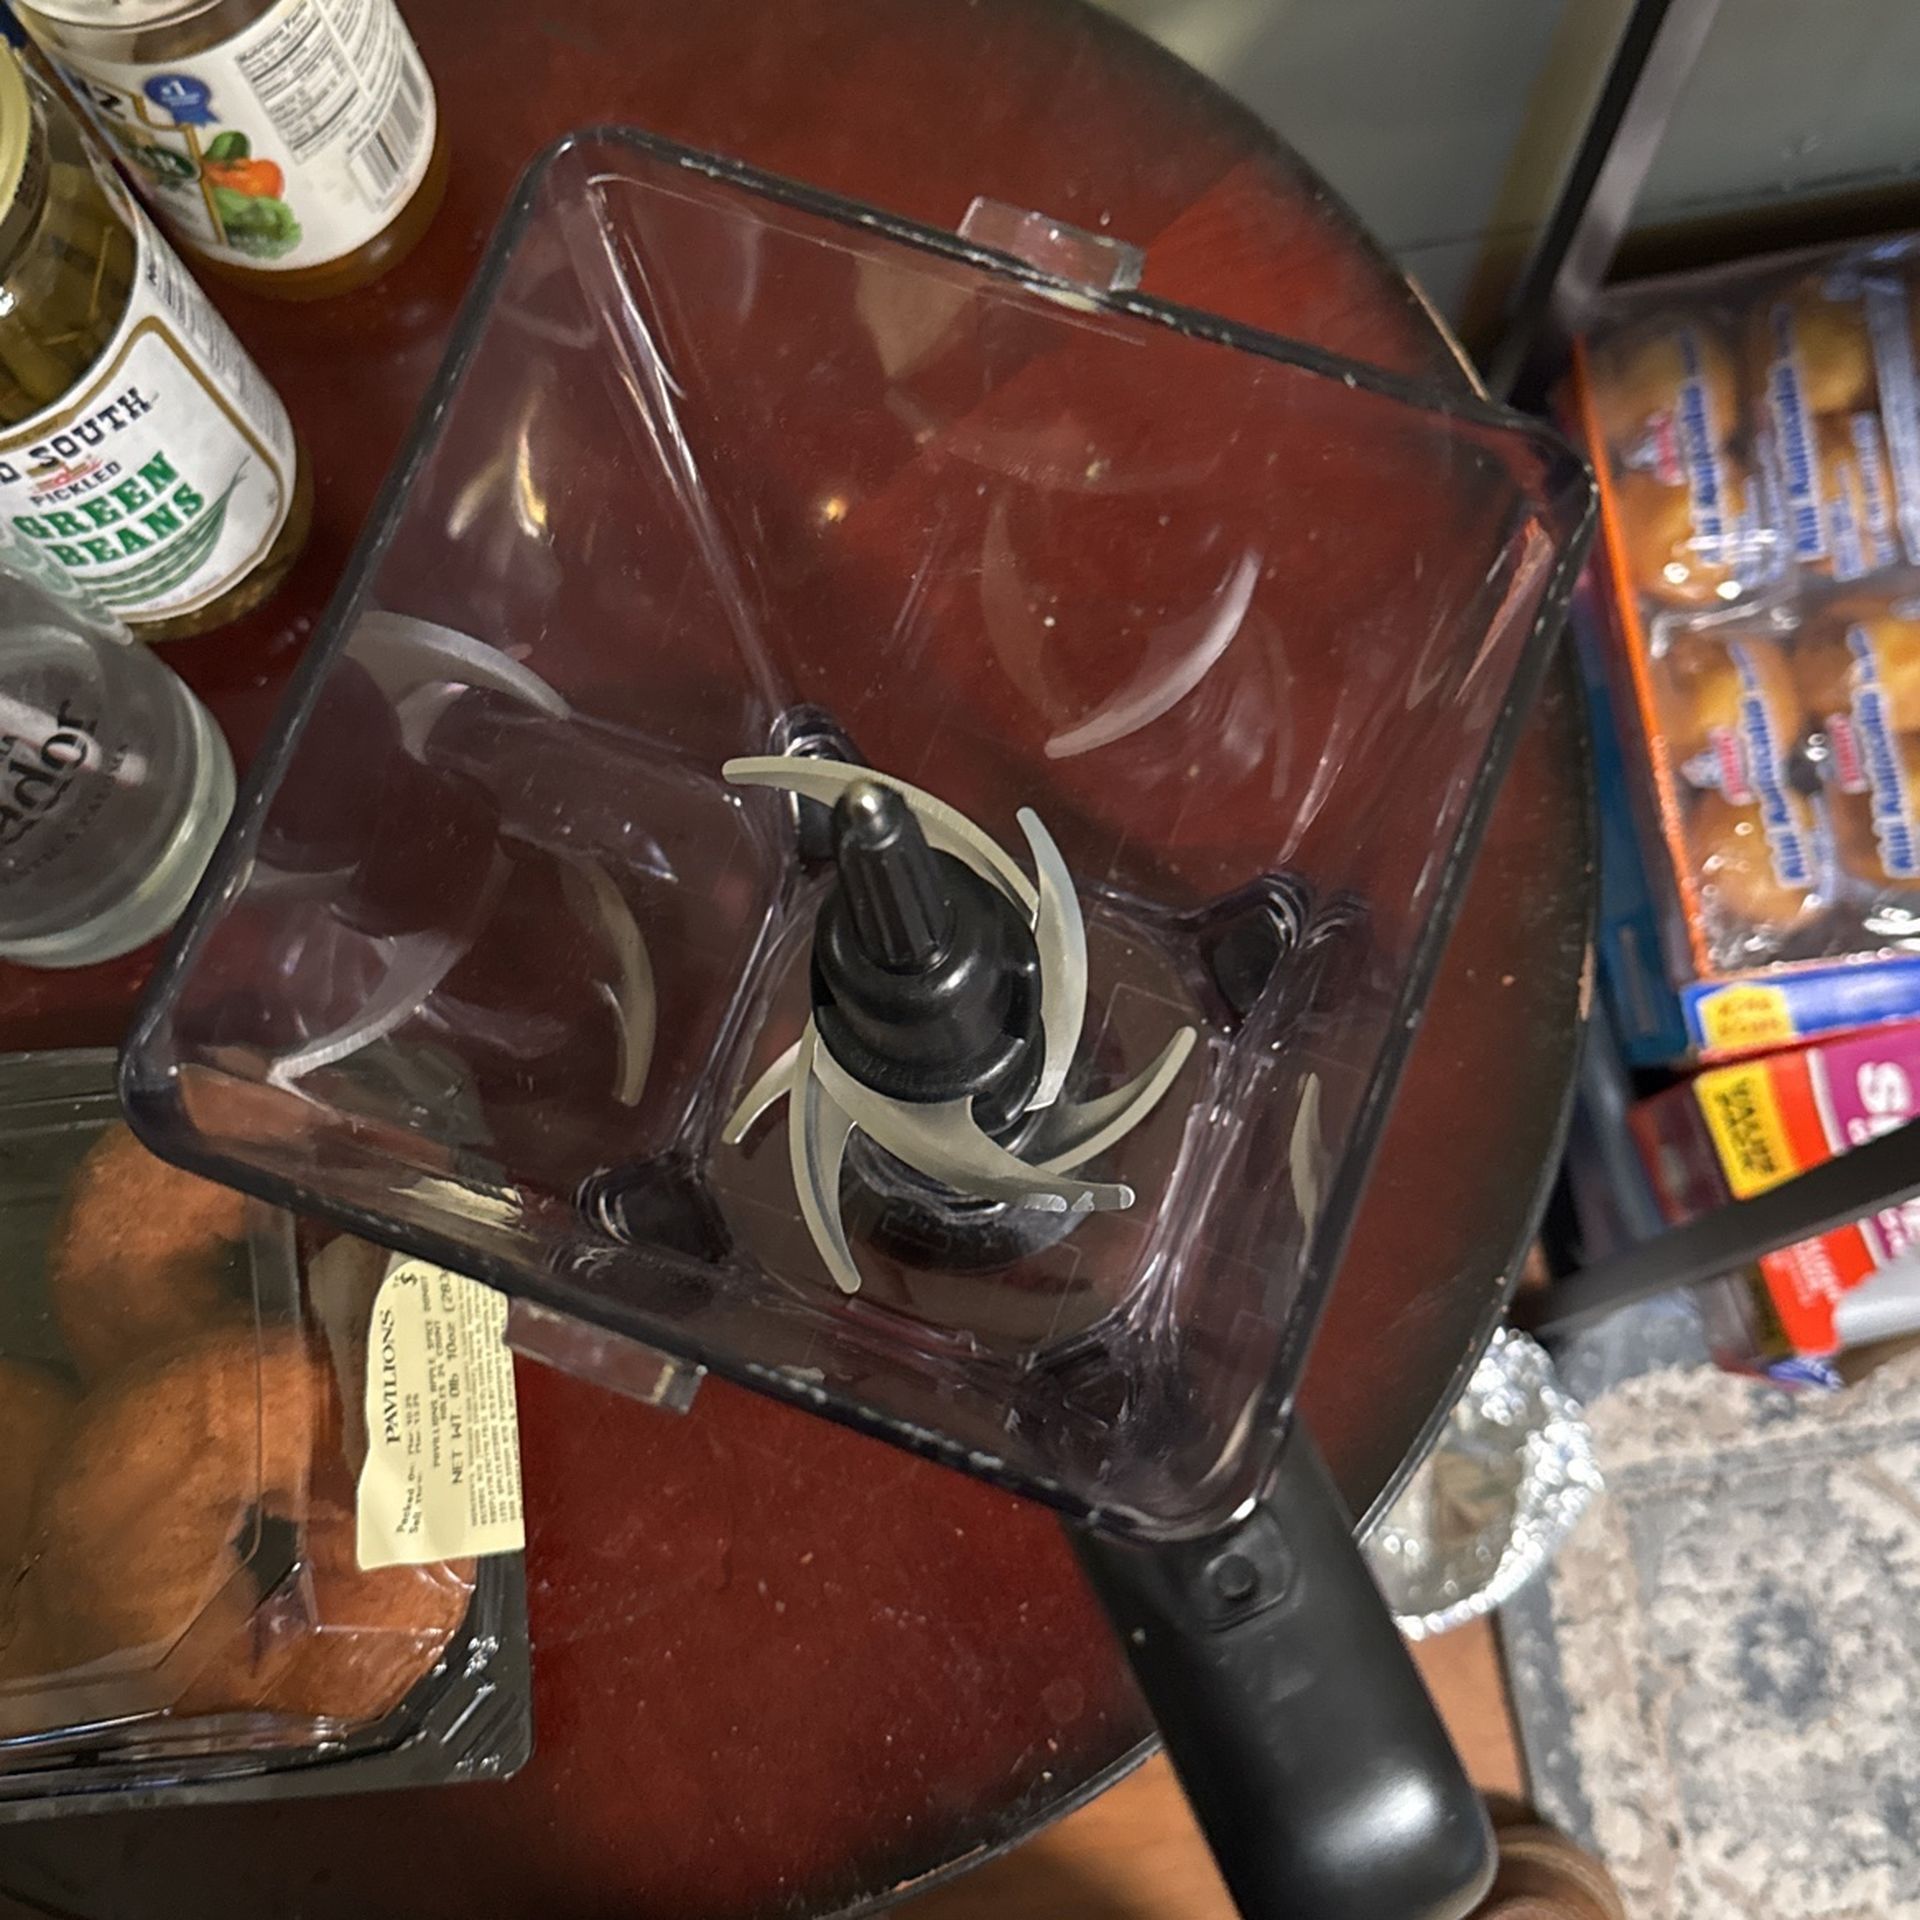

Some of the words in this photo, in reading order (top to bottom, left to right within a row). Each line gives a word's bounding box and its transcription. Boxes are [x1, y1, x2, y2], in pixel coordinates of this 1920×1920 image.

[28, 387, 154, 469] SOUTH
[12, 450, 180, 540] GREEN
[29, 460, 122, 507] PICKLED
[45, 483, 205, 566] BEANS
[382, 1309, 401, 1445] PAVILIONS
[451, 1450, 463, 1484] NET
